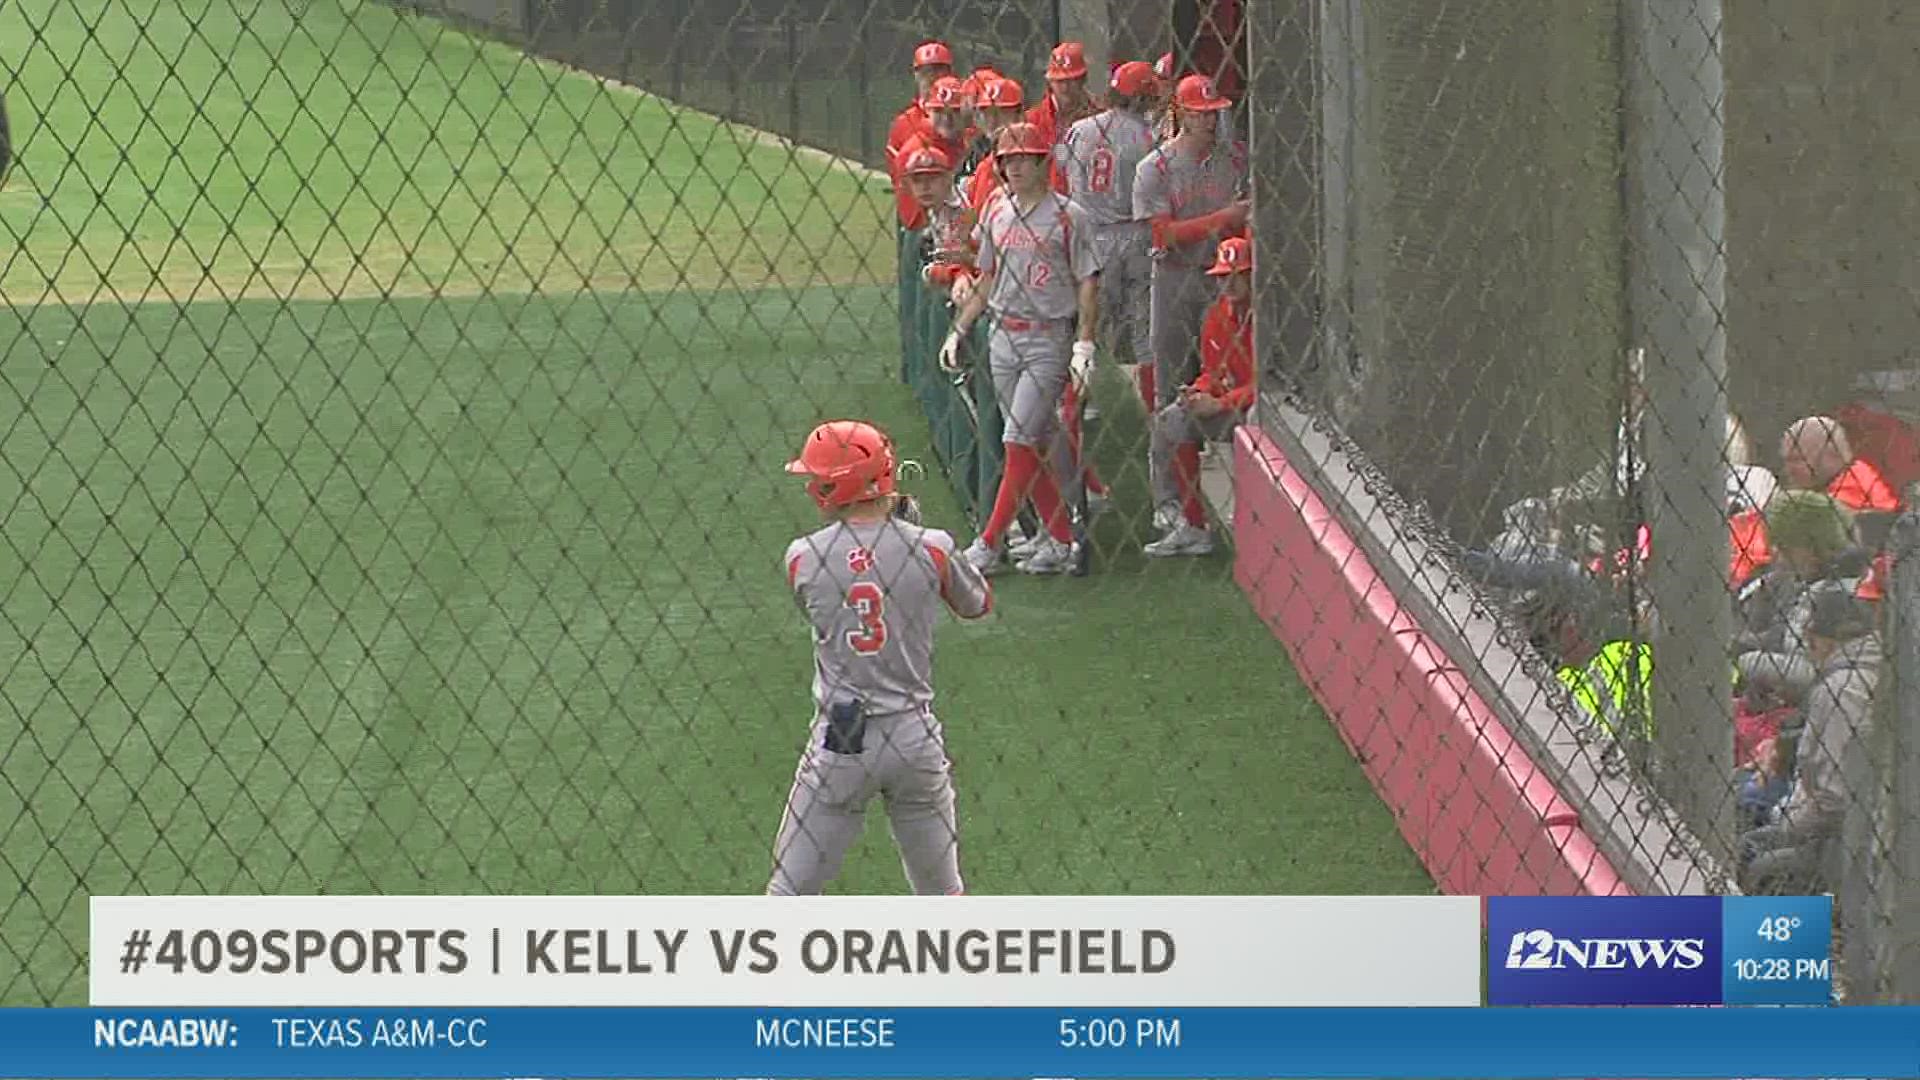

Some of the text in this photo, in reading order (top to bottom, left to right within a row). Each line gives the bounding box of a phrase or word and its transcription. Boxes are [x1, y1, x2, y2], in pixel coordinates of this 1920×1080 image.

[1088, 147, 1115, 193] 8
[1025, 261, 1053, 288] 12
[845, 582, 888, 656] 3
